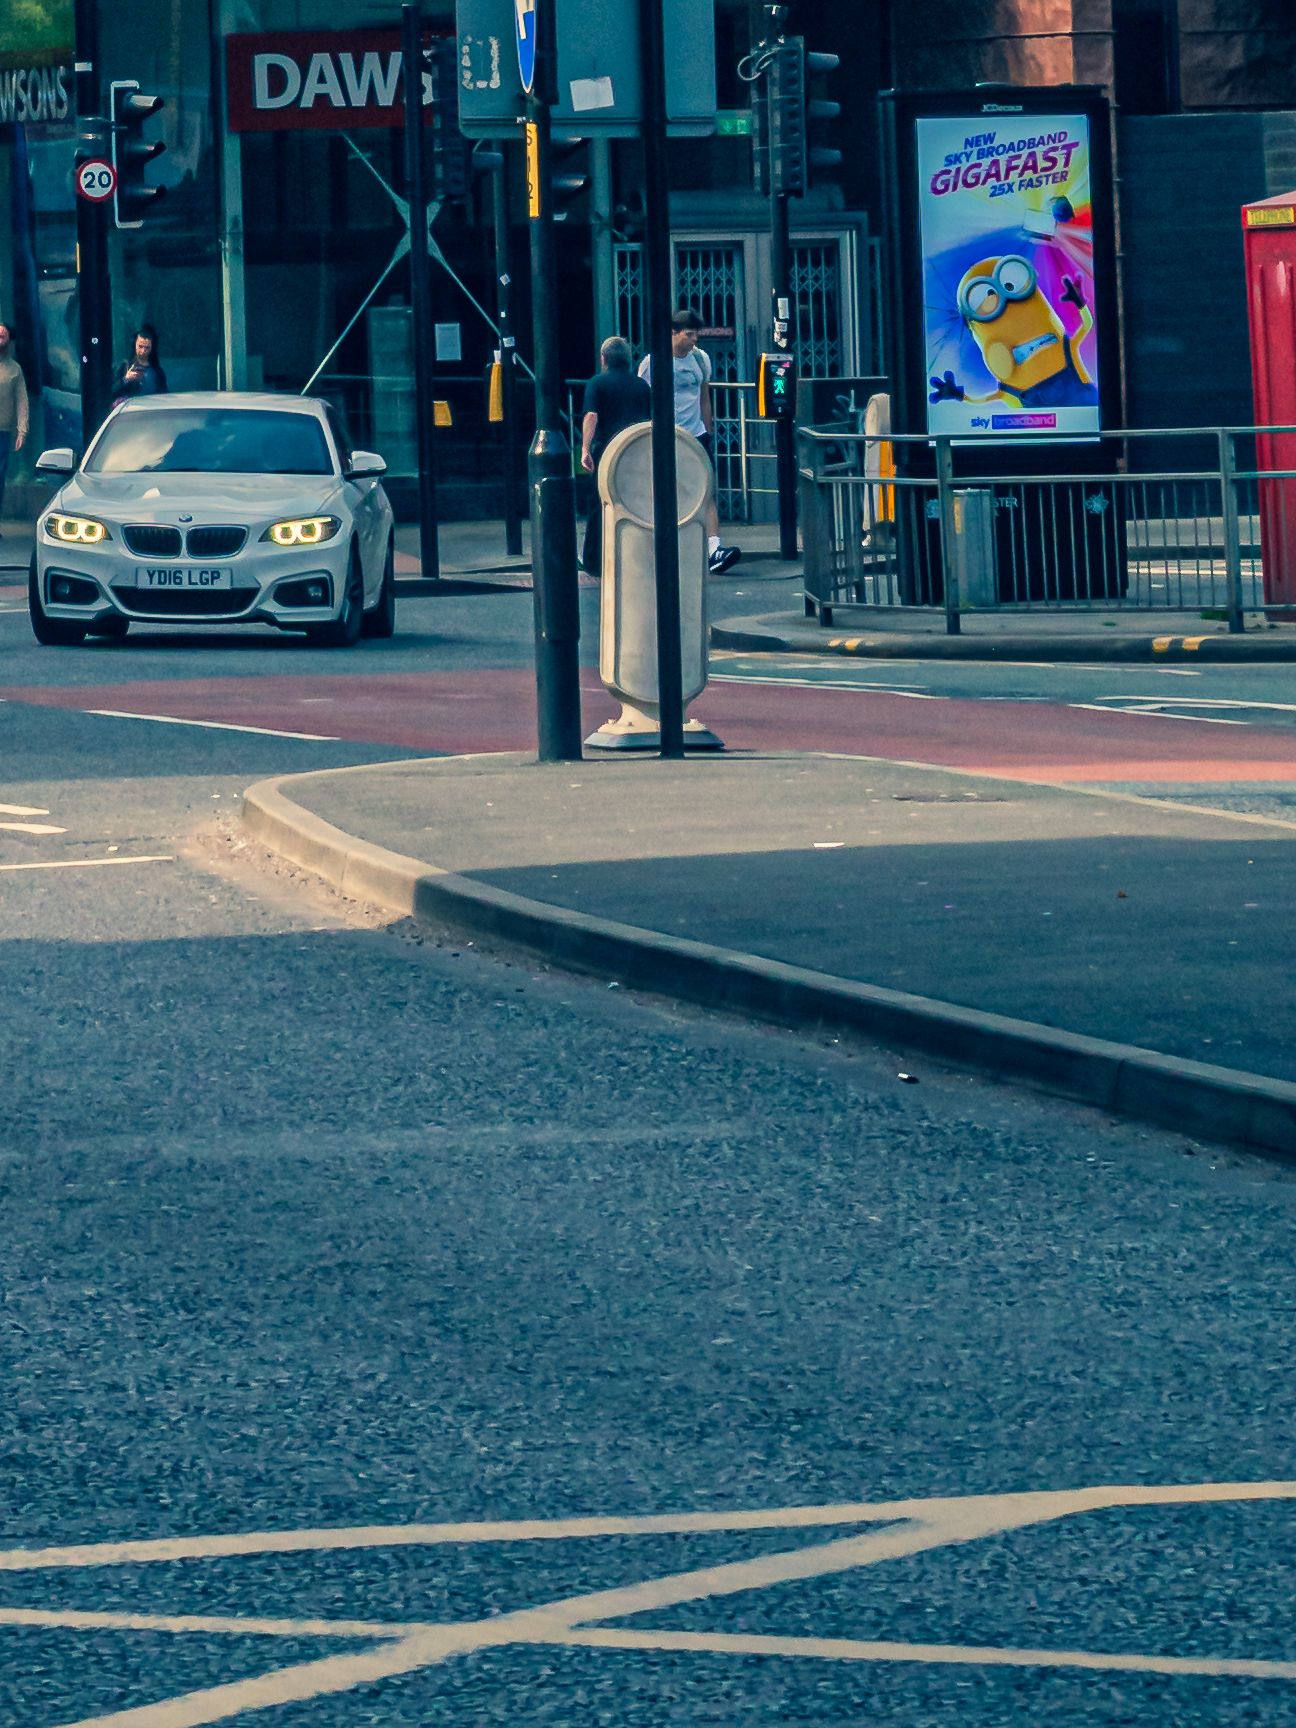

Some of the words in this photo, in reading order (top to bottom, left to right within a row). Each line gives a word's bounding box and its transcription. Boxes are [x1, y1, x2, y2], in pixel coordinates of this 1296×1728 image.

[944, 151, 973, 167] SKY
[977, 131, 1068, 160] BROADBAND
[964, 131, 997, 150] NEW
[930, 142, 1080, 196] GIGAFAST
[84, 171, 112, 188] 20
[989, 183, 1015, 198] 25X
[1018, 170, 1069, 192] FASTER
[971, 417, 990, 429] sky
[994, 415, 1055, 426] broadband
[147, 570, 183, 585] YD16
[188, 570, 221, 585] LGP
